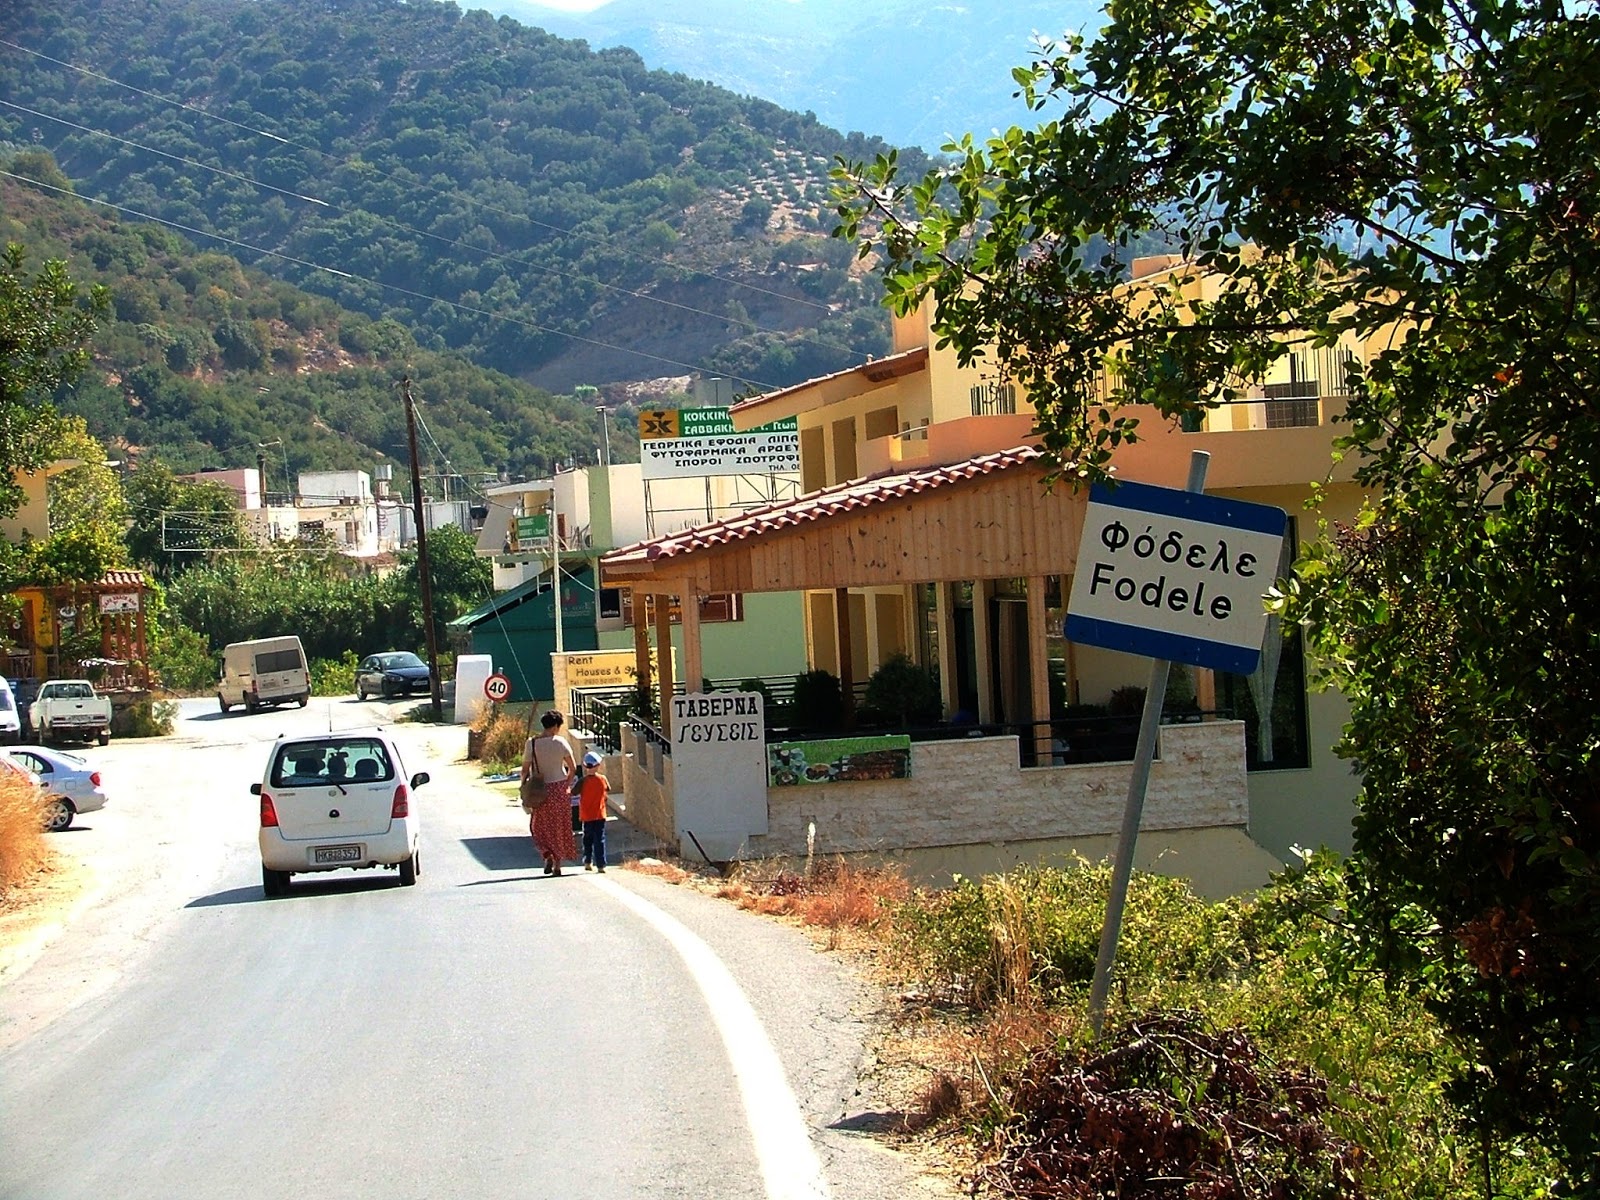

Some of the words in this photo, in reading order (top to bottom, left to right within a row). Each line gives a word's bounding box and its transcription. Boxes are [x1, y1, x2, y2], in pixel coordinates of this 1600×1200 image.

[643, 439, 702, 450] ΓΕΩΡΓΙΚΑ
[709, 437, 756, 447] ΕΦΟΔΙΑ
[768, 435, 798, 443] ΛΙΠΑ
[651, 446, 746, 458] ΦΥΤΟΦΑΡΜΑΚΑ
[758, 444, 799, 454] ΑΡΔΕΥ
[675, 459, 722, 467] ΣΠΟΡΟΙ
[1100, 520, 1257, 577] Φόδελε
[1090, 562, 1232, 620] Fodele
[568, 656, 592, 665] Rent
[576, 667, 611, 676] Houses
[614, 666, 621, 674] &
[488, 682, 506, 694] 40
[674, 697, 758, 718] ΤΑΒΕΡΝΑ
[678, 723, 758, 743] ΓΕΥΣΕΙΣ
